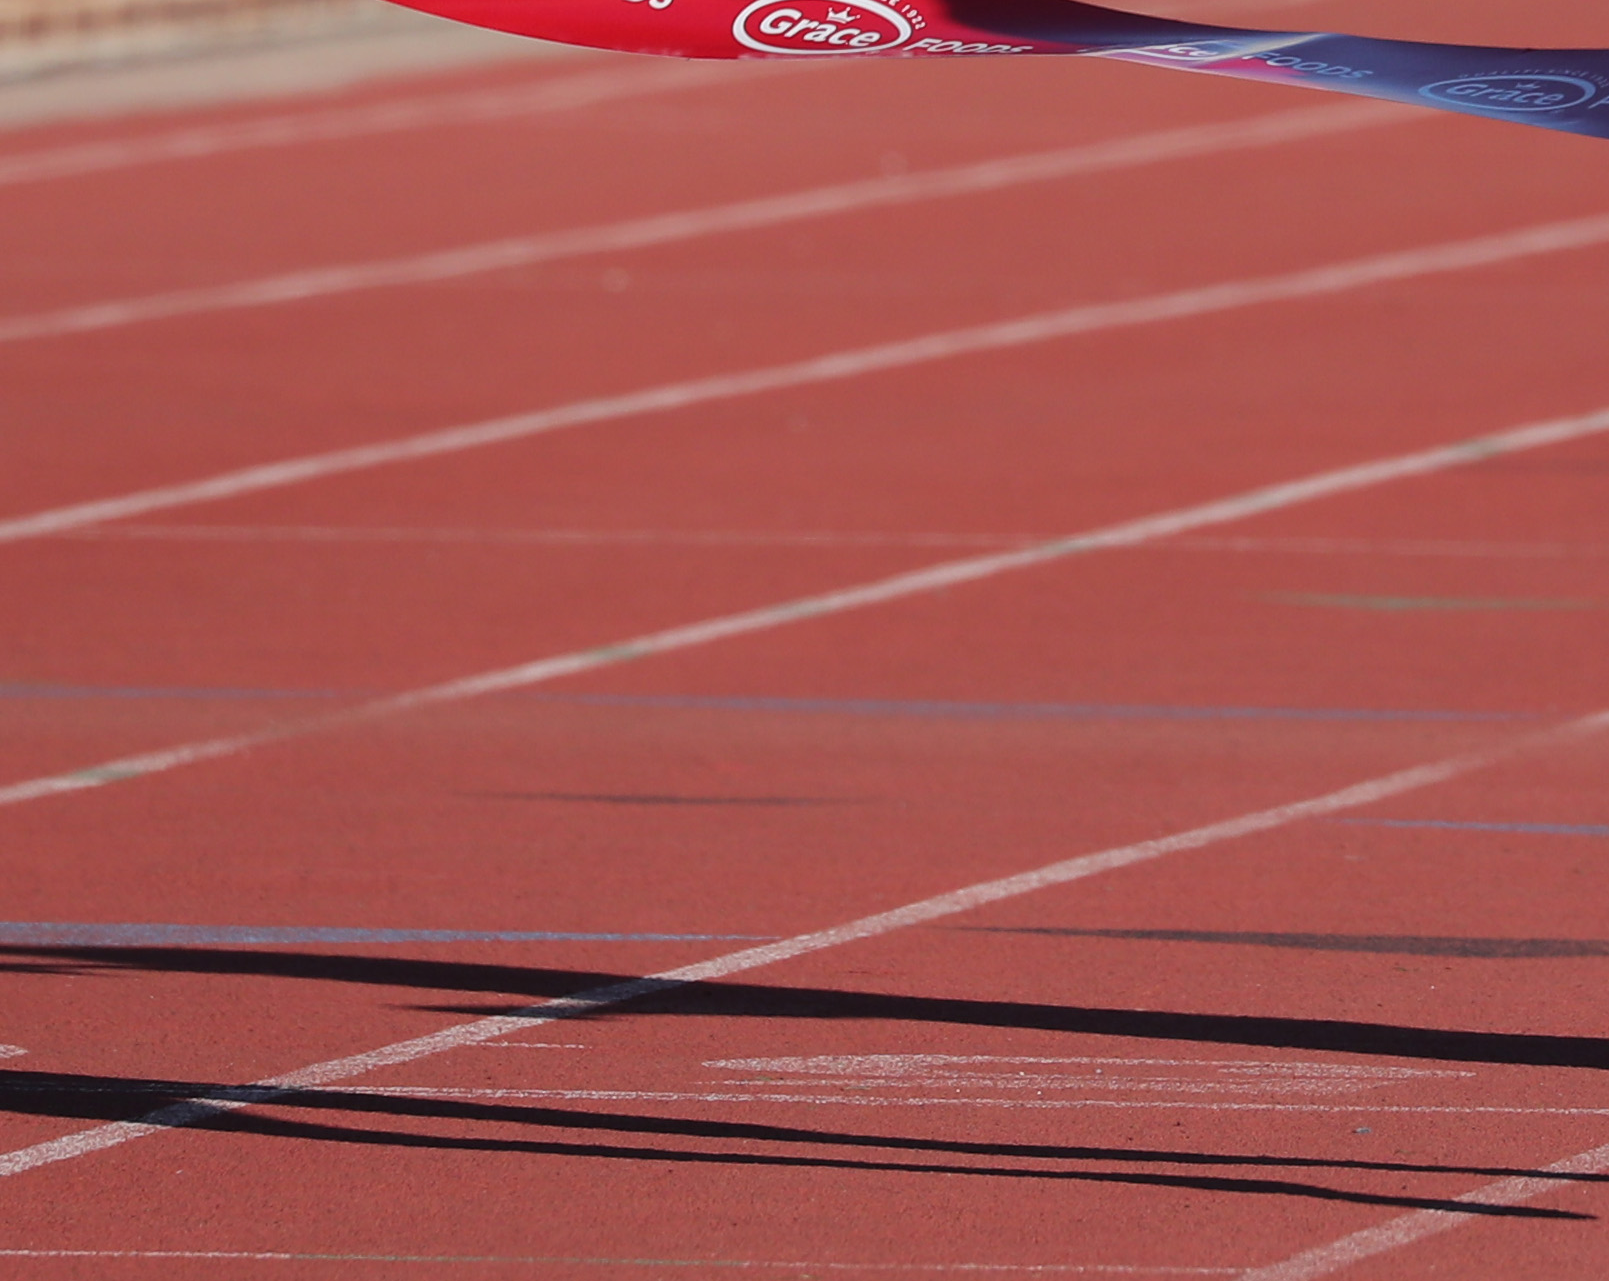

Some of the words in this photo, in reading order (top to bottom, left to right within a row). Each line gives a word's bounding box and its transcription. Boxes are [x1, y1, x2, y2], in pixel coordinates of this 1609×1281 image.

[758, 7, 882, 48] Grace
[902, 37, 1034, 54] FOODS
[1241, 50, 1374, 80] FOODS
[1445, 82, 1566, 106] Grace
